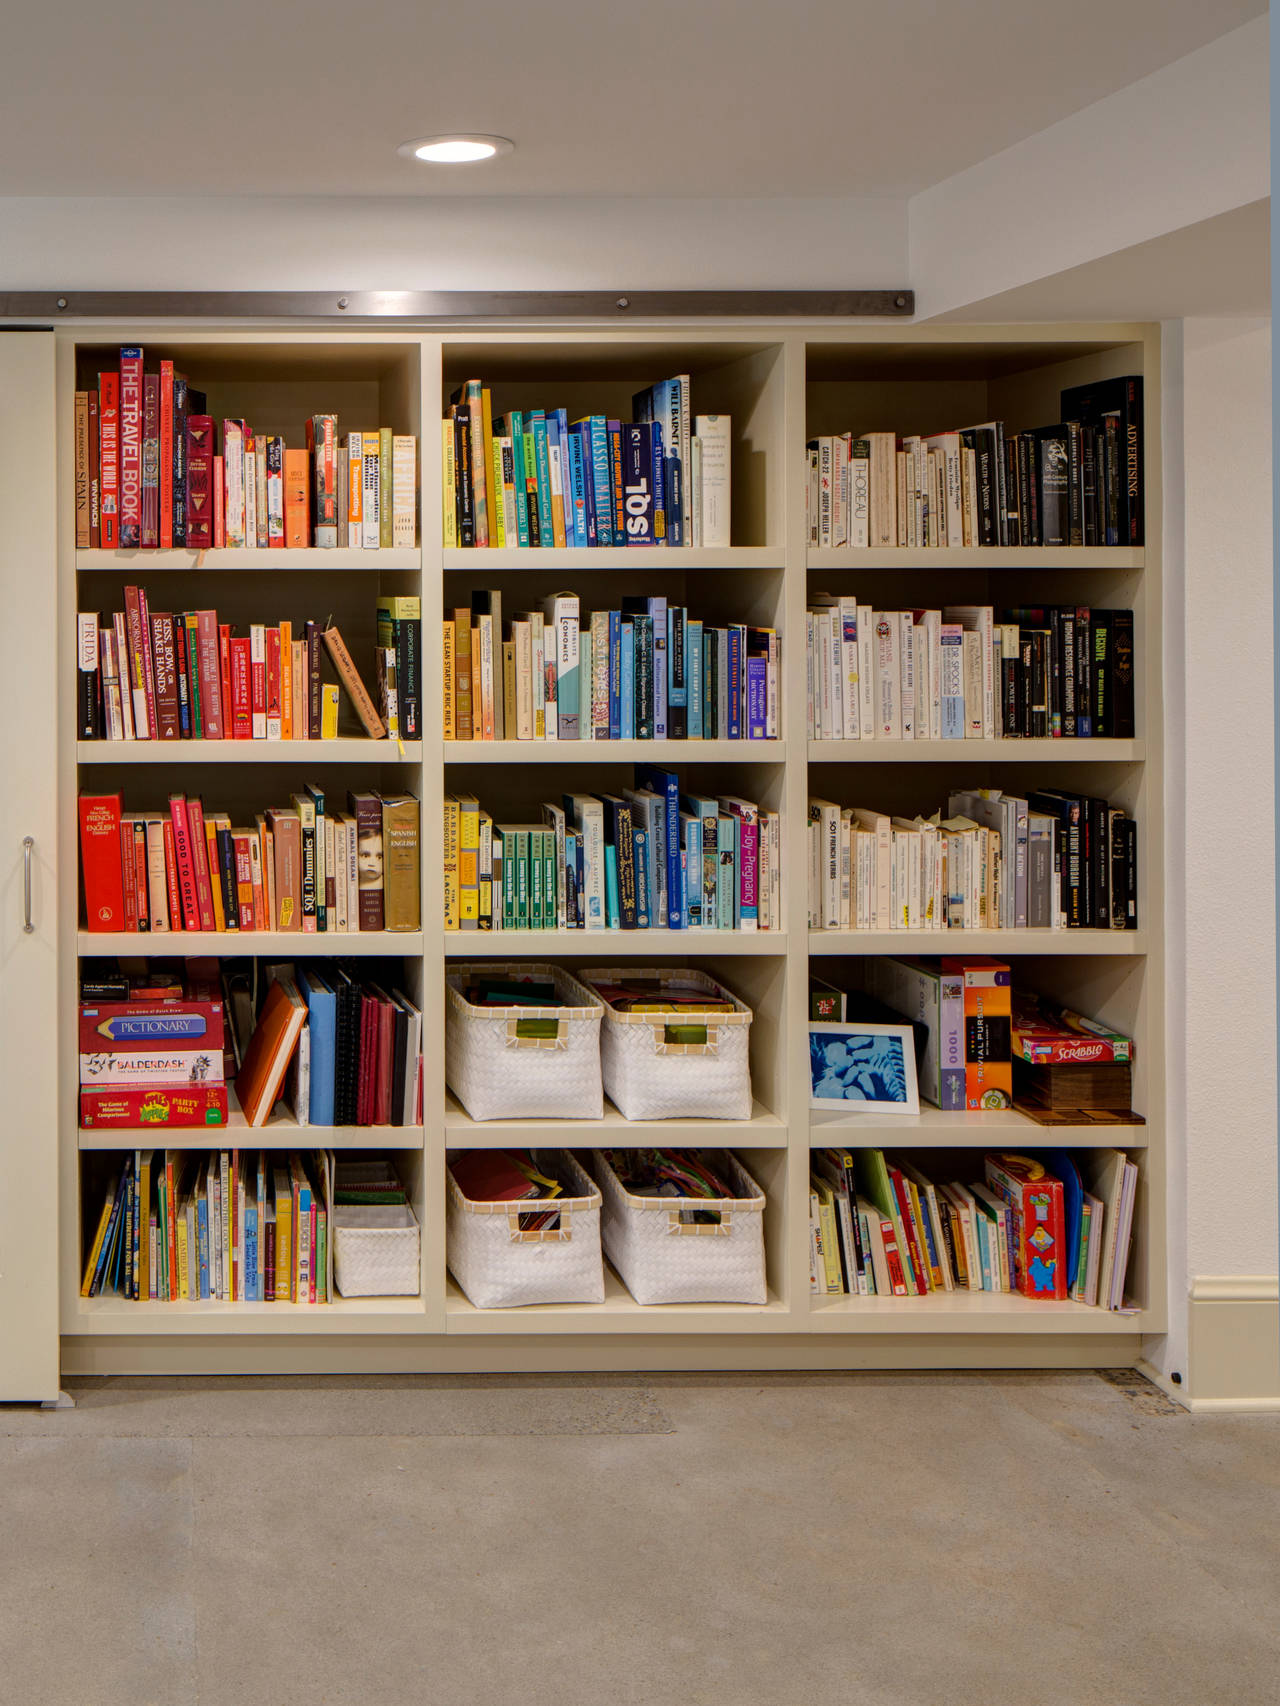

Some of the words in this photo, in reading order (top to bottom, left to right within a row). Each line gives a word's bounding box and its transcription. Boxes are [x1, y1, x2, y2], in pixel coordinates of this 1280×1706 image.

[123, 362, 138, 398] THE
[103, 423, 116, 439] THIS
[123, 400, 139, 466] TRAVEL
[671, 409, 679, 446] BARNET
[103, 451, 116, 463] THE
[574, 436, 582, 464] IRVINE
[592, 419, 608, 470] PICASSO
[1127, 424, 1138, 497] ADVERTISING
[103, 465, 116, 488] WORLD
[575, 466, 583, 496] WELSH
[980, 453, 988, 478] WEALTH
[77, 472, 86, 510] SPAIN
[123, 470, 139, 520] BOOK
[626, 478, 651, 535] SQL
[855, 463, 866, 519] THOREAU
[982, 485, 990, 511] NATIONS
[595, 485, 611, 531] MAILER
[84, 622, 95, 663] FRIDA
[130, 608, 141, 651] ABNORMAL
[154, 619, 163, 653] SHAKE
[163, 618, 172, 643] KISS,
[1065, 622, 1073, 644] HUMAN
[1096, 628, 1107, 661] DECISIVE
[156, 657, 166, 694] HANDS
[165, 647, 173, 672] BOW,
[1065, 646, 1073, 676] RESOURCE
[952, 661, 960, 695] SPOCK'S
[1066, 677, 1074, 712] CHAMPIONS
[668, 795, 677, 857] THUNDERBIRD
[1070, 826, 1079, 854] ANTHONY
[178, 830, 186, 858] GOOD
[742, 835, 755, 850] Joy
[182, 864, 189, 876] TO
[304, 838, 314, 884] Dummies
[1070, 855, 1079, 887] BOURDAIN
[742, 856, 756, 905] Pregnancy
[184, 882, 193, 914] GREAT
[304, 892, 315, 911] SQL
[121, 1020, 190, 1032] PICTIONARY
[977, 996, 985, 1041] PURSUIT
[948, 1029, 957, 1063] 1000
[1056, 1044, 1103, 1061] SCRABBLE
[118, 1060, 185, 1068] BALDERDASH
[977, 1044, 985, 1084] TRIVIAL
[172, 1098, 199, 1106] PARTY
[178, 1106, 194, 1114] BOX
